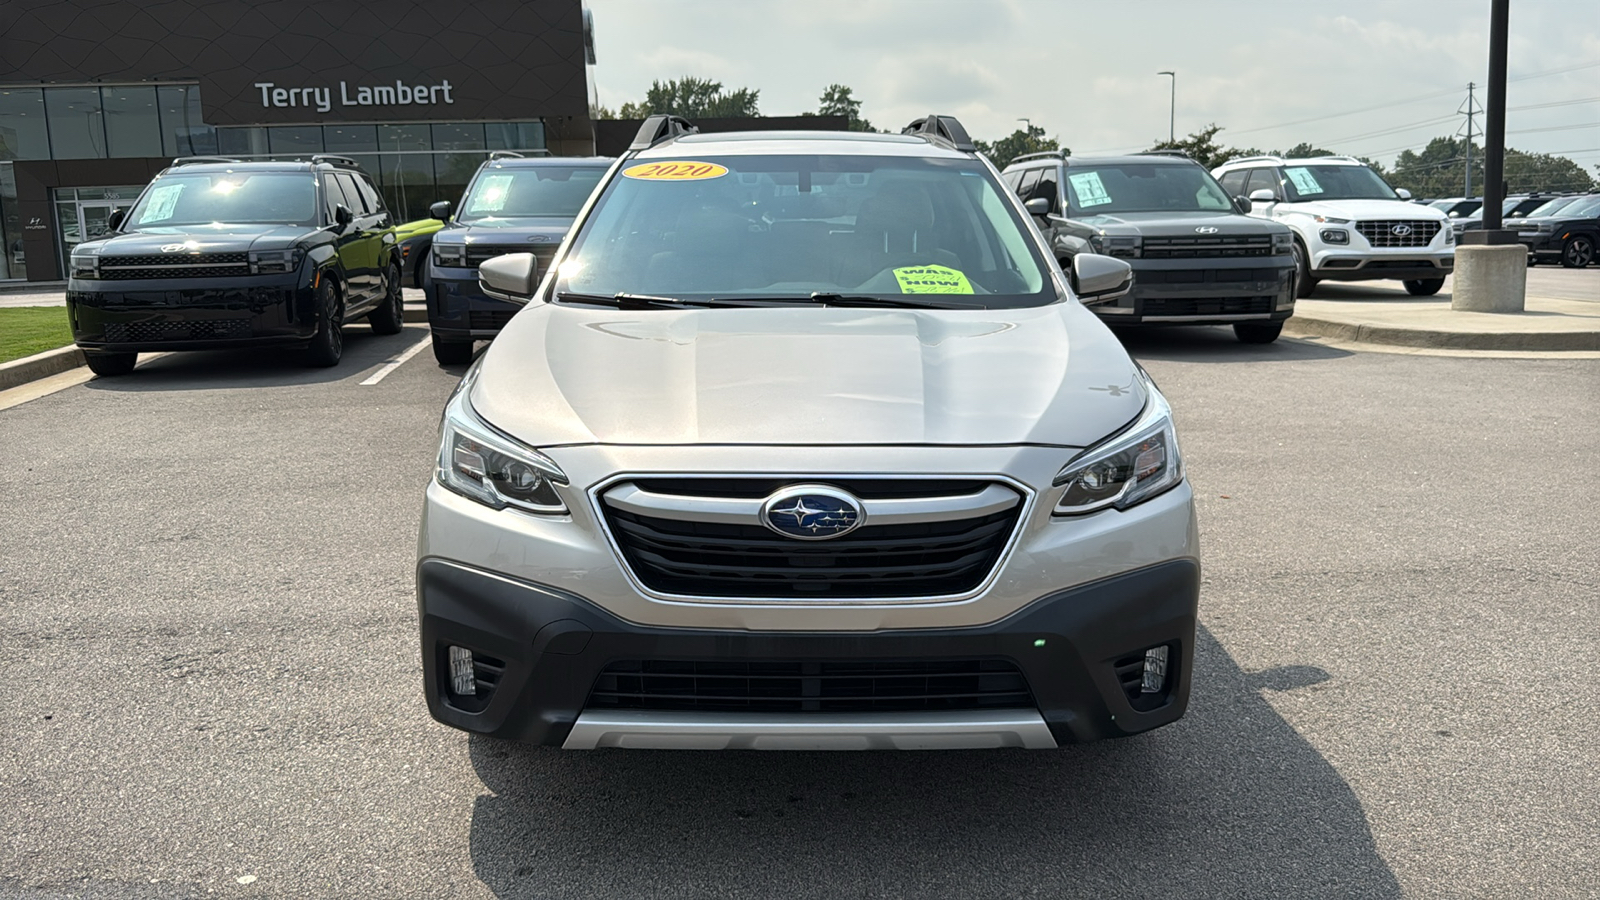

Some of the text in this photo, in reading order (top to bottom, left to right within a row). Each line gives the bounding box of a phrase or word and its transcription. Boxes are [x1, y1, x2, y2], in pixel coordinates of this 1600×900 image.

[254, 80, 454, 113] Terry Lambert
[637, 165, 713, 177] 2020
